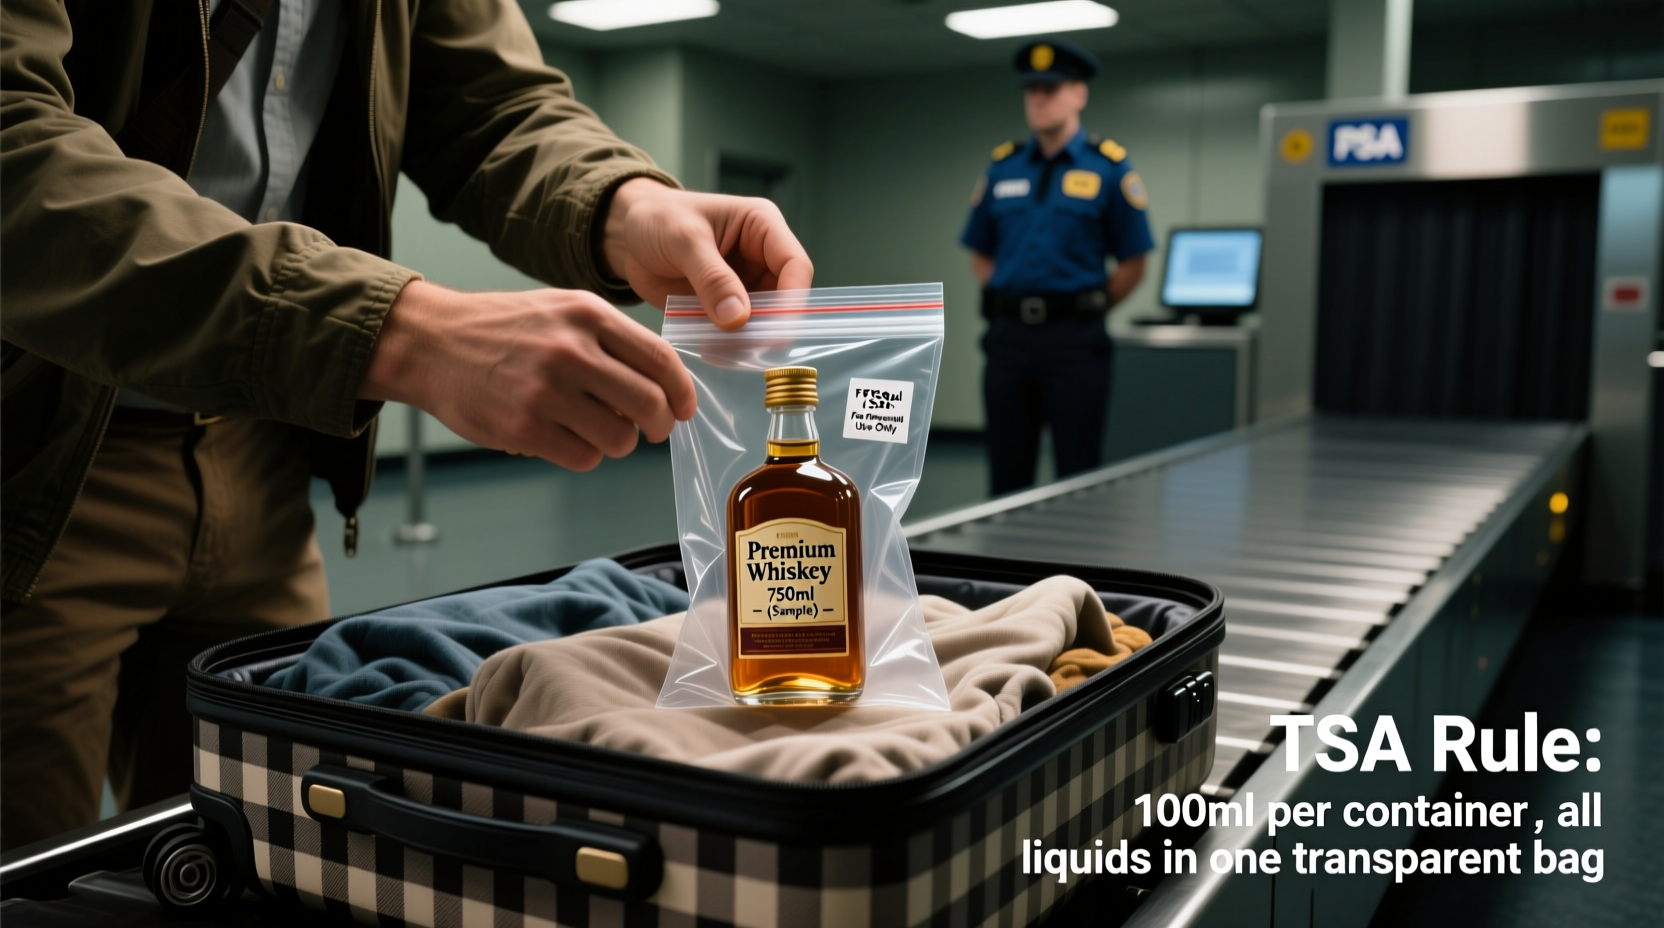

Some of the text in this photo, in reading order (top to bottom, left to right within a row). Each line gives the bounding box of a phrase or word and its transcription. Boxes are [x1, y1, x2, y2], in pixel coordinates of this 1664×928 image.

[747, 539, 836, 560] Premium
[747, 561, 832, 585] Whiskey
[767, 586, 815, 602] 750ml
[767, 603, 819, 620] (Sample)
